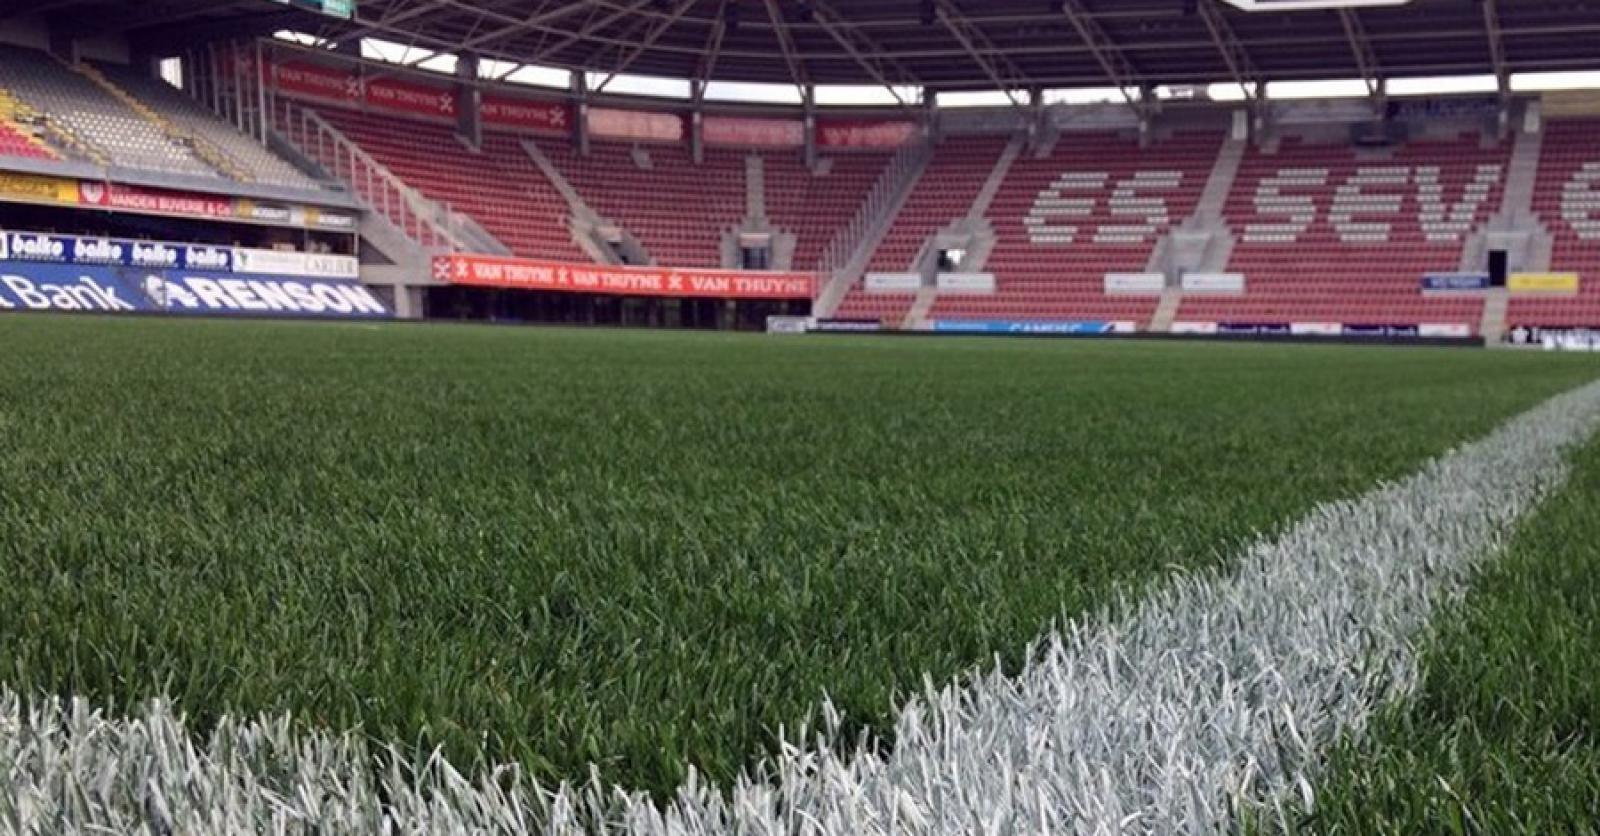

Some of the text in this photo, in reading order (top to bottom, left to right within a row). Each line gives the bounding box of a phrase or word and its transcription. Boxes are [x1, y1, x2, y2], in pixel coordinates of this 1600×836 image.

[370, 85, 396, 99] VAN
[1023, 170, 1183, 242] ES
[1242, 164, 1504, 241] SEV
[472, 261, 554, 283] VAN THUYNE
[573, 270, 661, 290] VAN THUYNE
[0, 274, 135, 310] Bank
[691, 276, 808, 293] VAN THUYNE
[183, 278, 386, 314] RENSON
